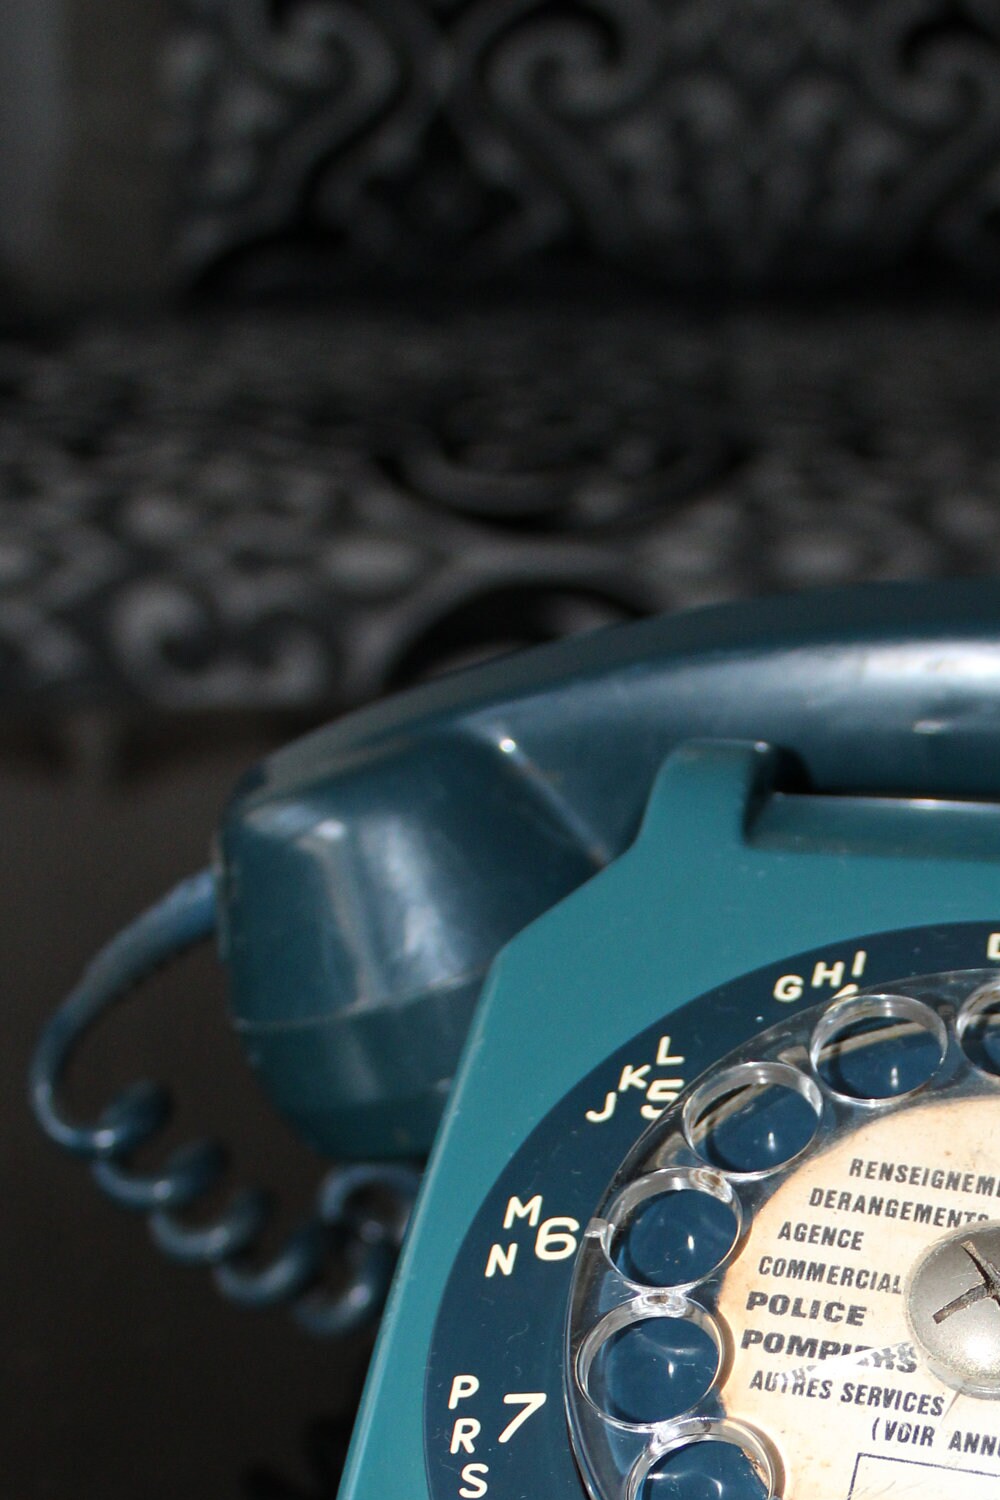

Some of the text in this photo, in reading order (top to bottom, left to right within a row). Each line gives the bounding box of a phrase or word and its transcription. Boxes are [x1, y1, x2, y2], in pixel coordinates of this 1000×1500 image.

[534, 1216, 580, 1260] 6
[777, 1221, 864, 1251] AGENCE
[746, 1291, 866, 1327] POLICE
[840, 1381, 945, 1417] SERVICES
[498, 1392, 547, 1443] 7
